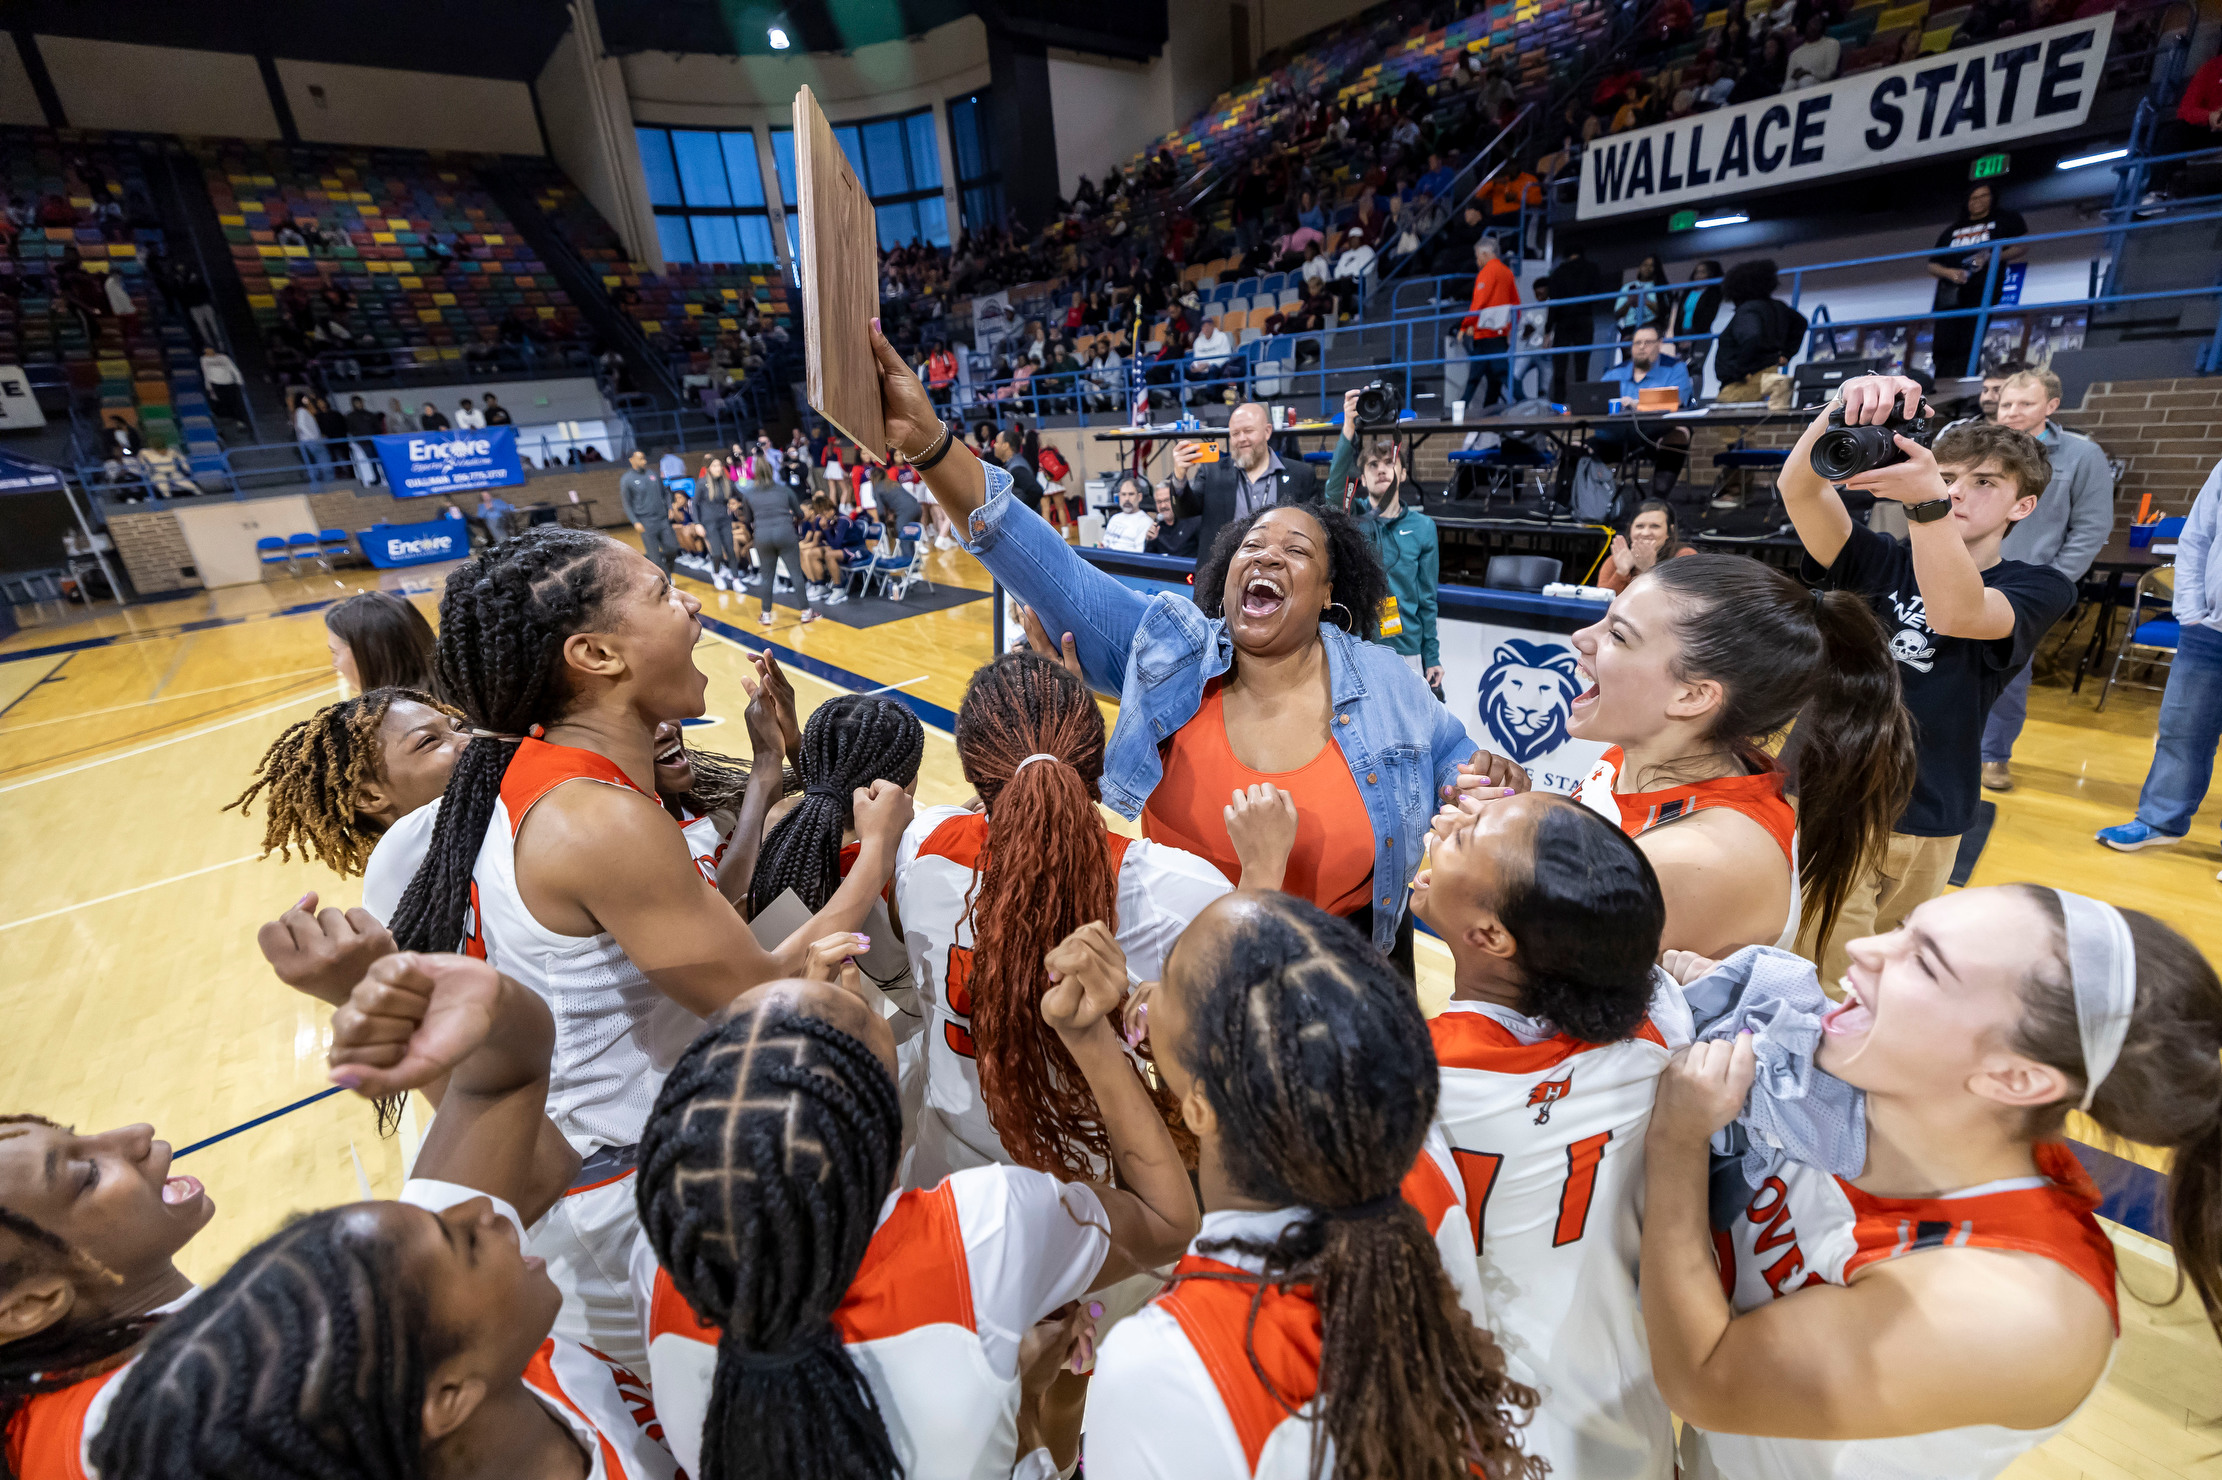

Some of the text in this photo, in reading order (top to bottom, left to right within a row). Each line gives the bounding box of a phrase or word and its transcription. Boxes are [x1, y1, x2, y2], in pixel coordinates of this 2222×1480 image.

[1594, 29, 2095, 205] WALLACE STATE
[1974, 153, 2006, 178] EXIT
[408, 438, 491, 462] Encore
[387, 535, 453, 556] Encore
